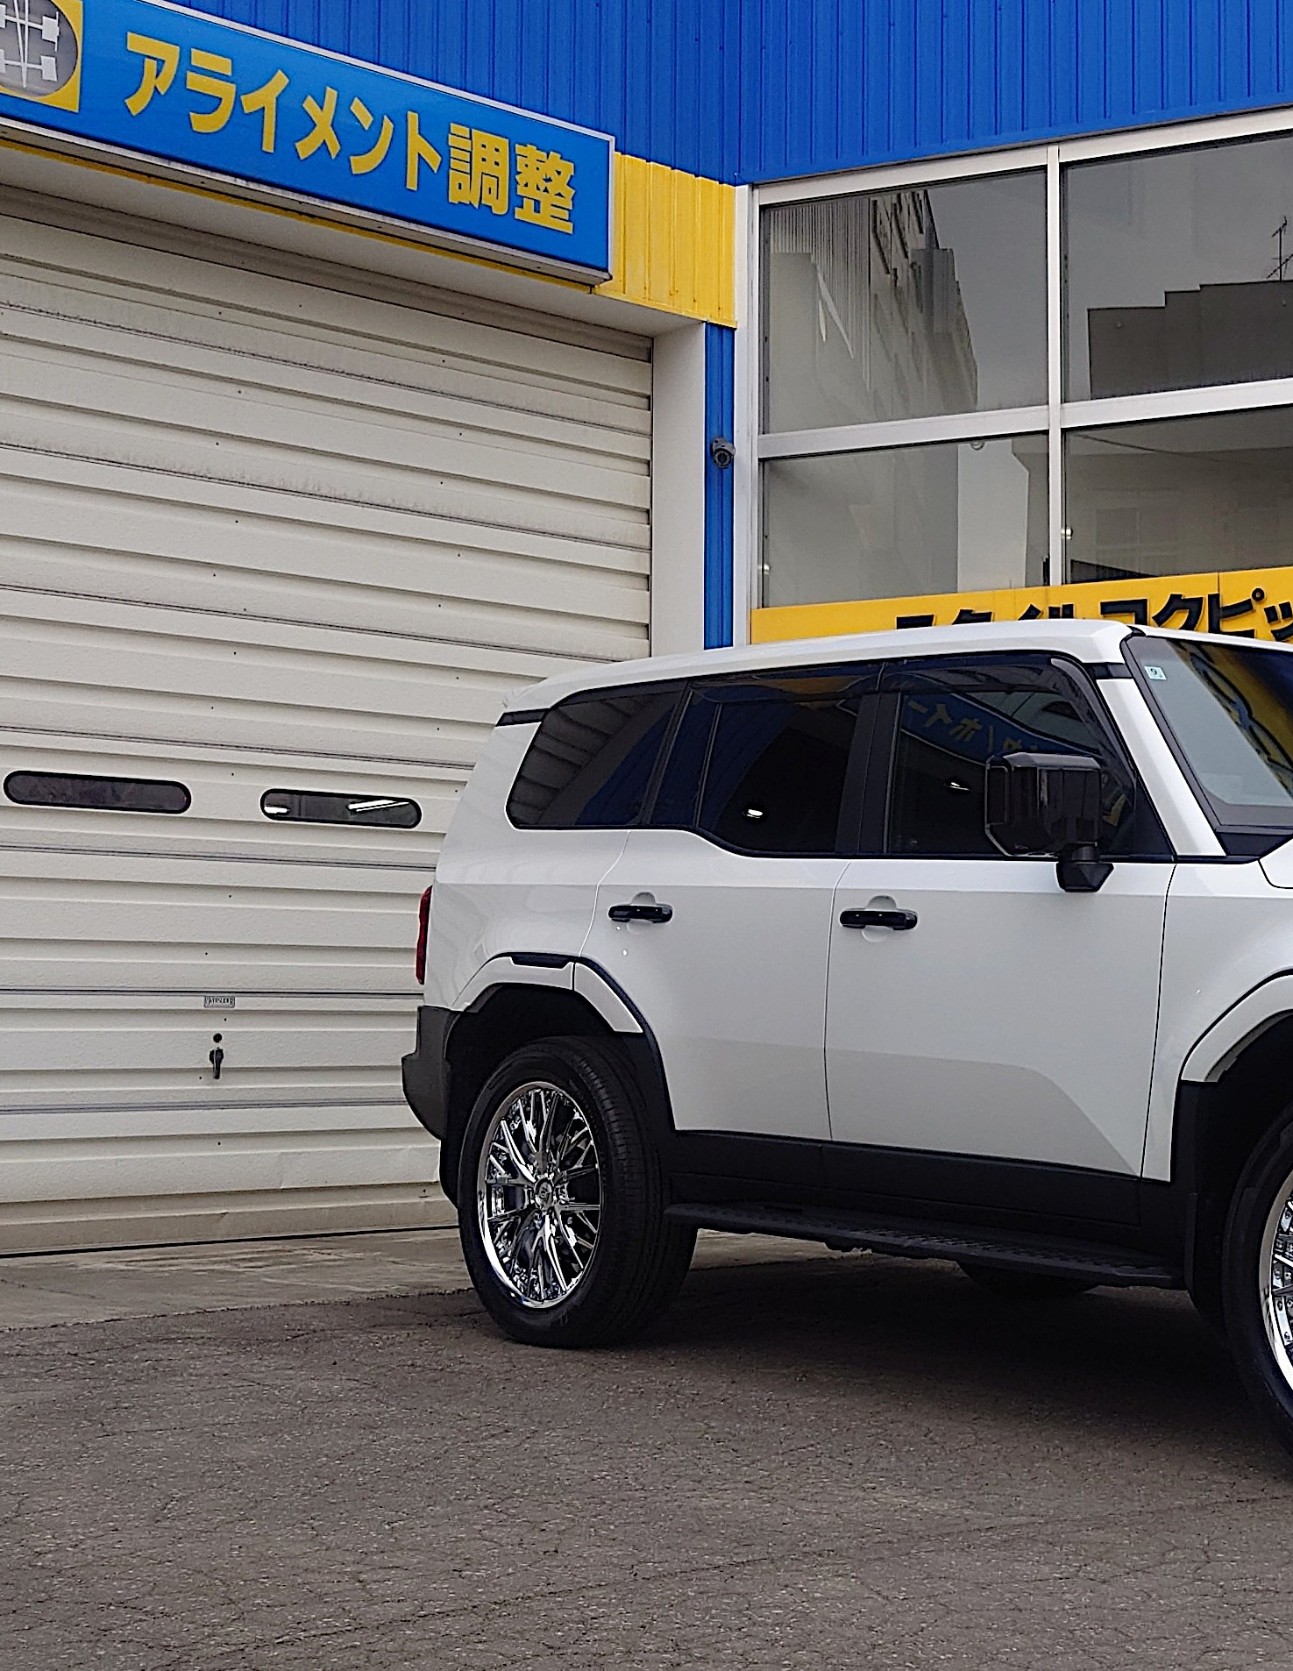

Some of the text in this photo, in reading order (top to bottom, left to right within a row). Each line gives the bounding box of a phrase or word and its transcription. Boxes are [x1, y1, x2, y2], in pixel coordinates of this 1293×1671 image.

[125, 31, 576, 233] アライメント調整
